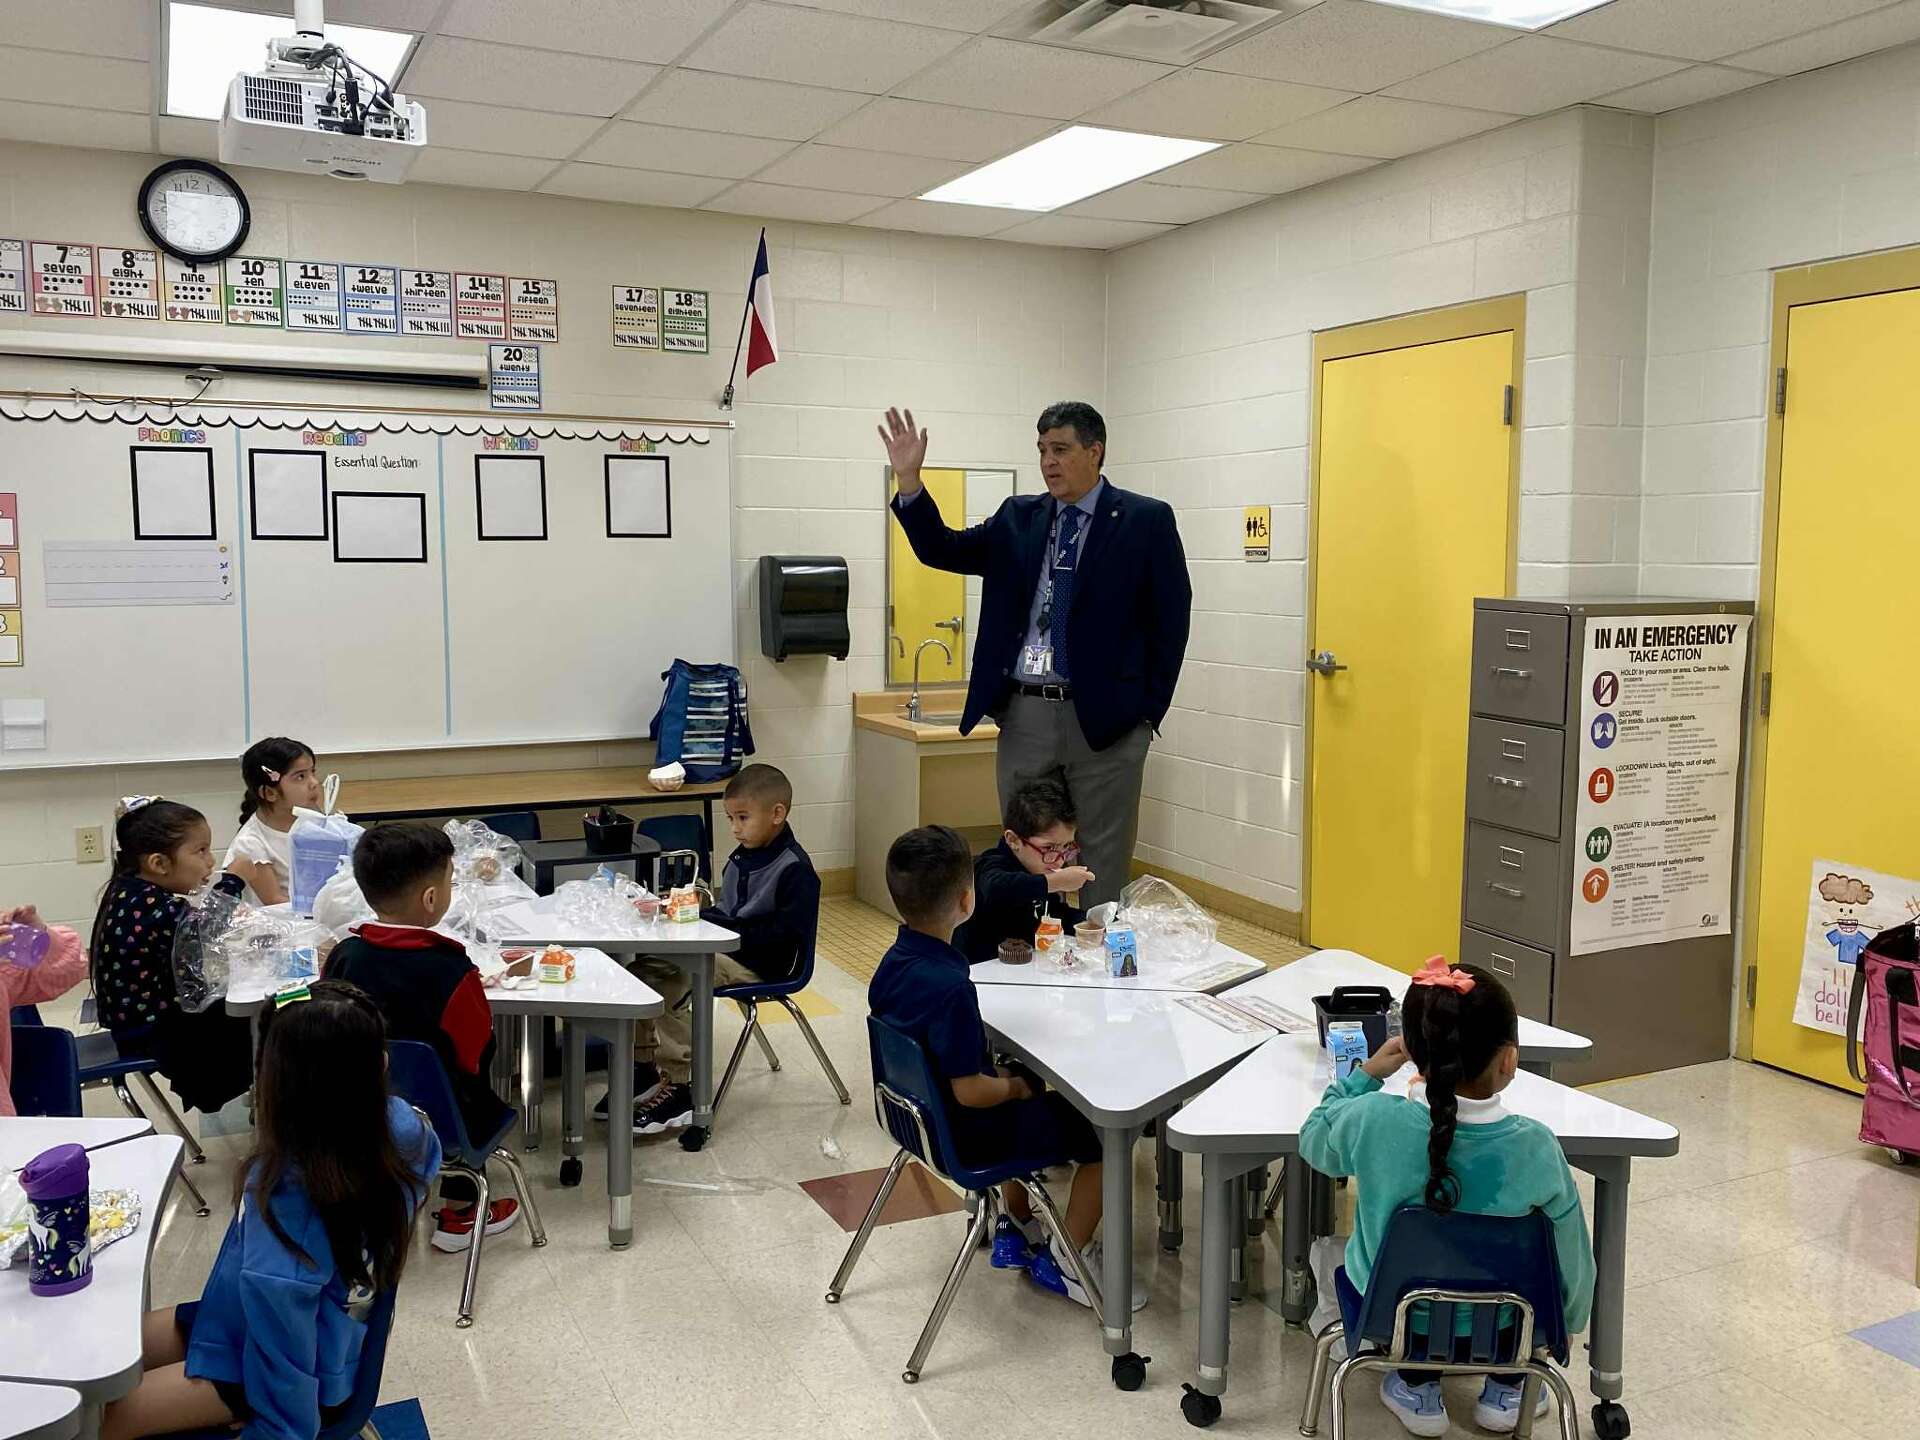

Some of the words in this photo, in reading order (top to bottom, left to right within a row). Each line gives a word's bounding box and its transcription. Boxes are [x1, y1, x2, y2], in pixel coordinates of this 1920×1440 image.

[186, 180, 199, 190] 12
[55, 246, 69, 264] 7
[122, 251, 136, 268] 8
[43, 262, 82, 275] seven
[112, 267, 144, 280] eight
[241, 260, 264, 276] 10
[300, 264, 322, 280] 11
[180, 272, 206, 283] nine
[244, 276, 265, 287] ten
[358, 269, 380, 284] 12
[414, 273, 434, 288] 13
[294, 280, 330, 291] eleven
[351, 284, 388, 295] twelve
[468, 277, 489, 291] 14
[522, 281, 541, 295] 15
[405, 287, 446, 298] thirteen
[460, 291, 501, 301] fourteen
[626, 289, 643, 302] 17
[517, 295, 549, 305] fifteen
[675, 293, 693, 306] 18
[615, 303, 656, 313] seventeen
[668, 307, 702, 317] eighteen
[504, 348, 523, 361] 20
[500, 363, 530, 373] twenty
[138, 427, 207, 443] Phonics
[303, 431, 367, 446] Reading
[483, 436, 538, 451] Writing
[334, 456, 378, 469] Essential
[1595, 628, 1612, 649] IN
[1615, 627, 1637, 648] AN
[1642, 624, 1738, 648] EMERGENCY
[1629, 650, 1658, 663] TAKE
[1660, 648, 1702, 662] ACTION
[1815, 980, 1847, 1009] doll
[1816, 1004, 1847, 1027] bell
